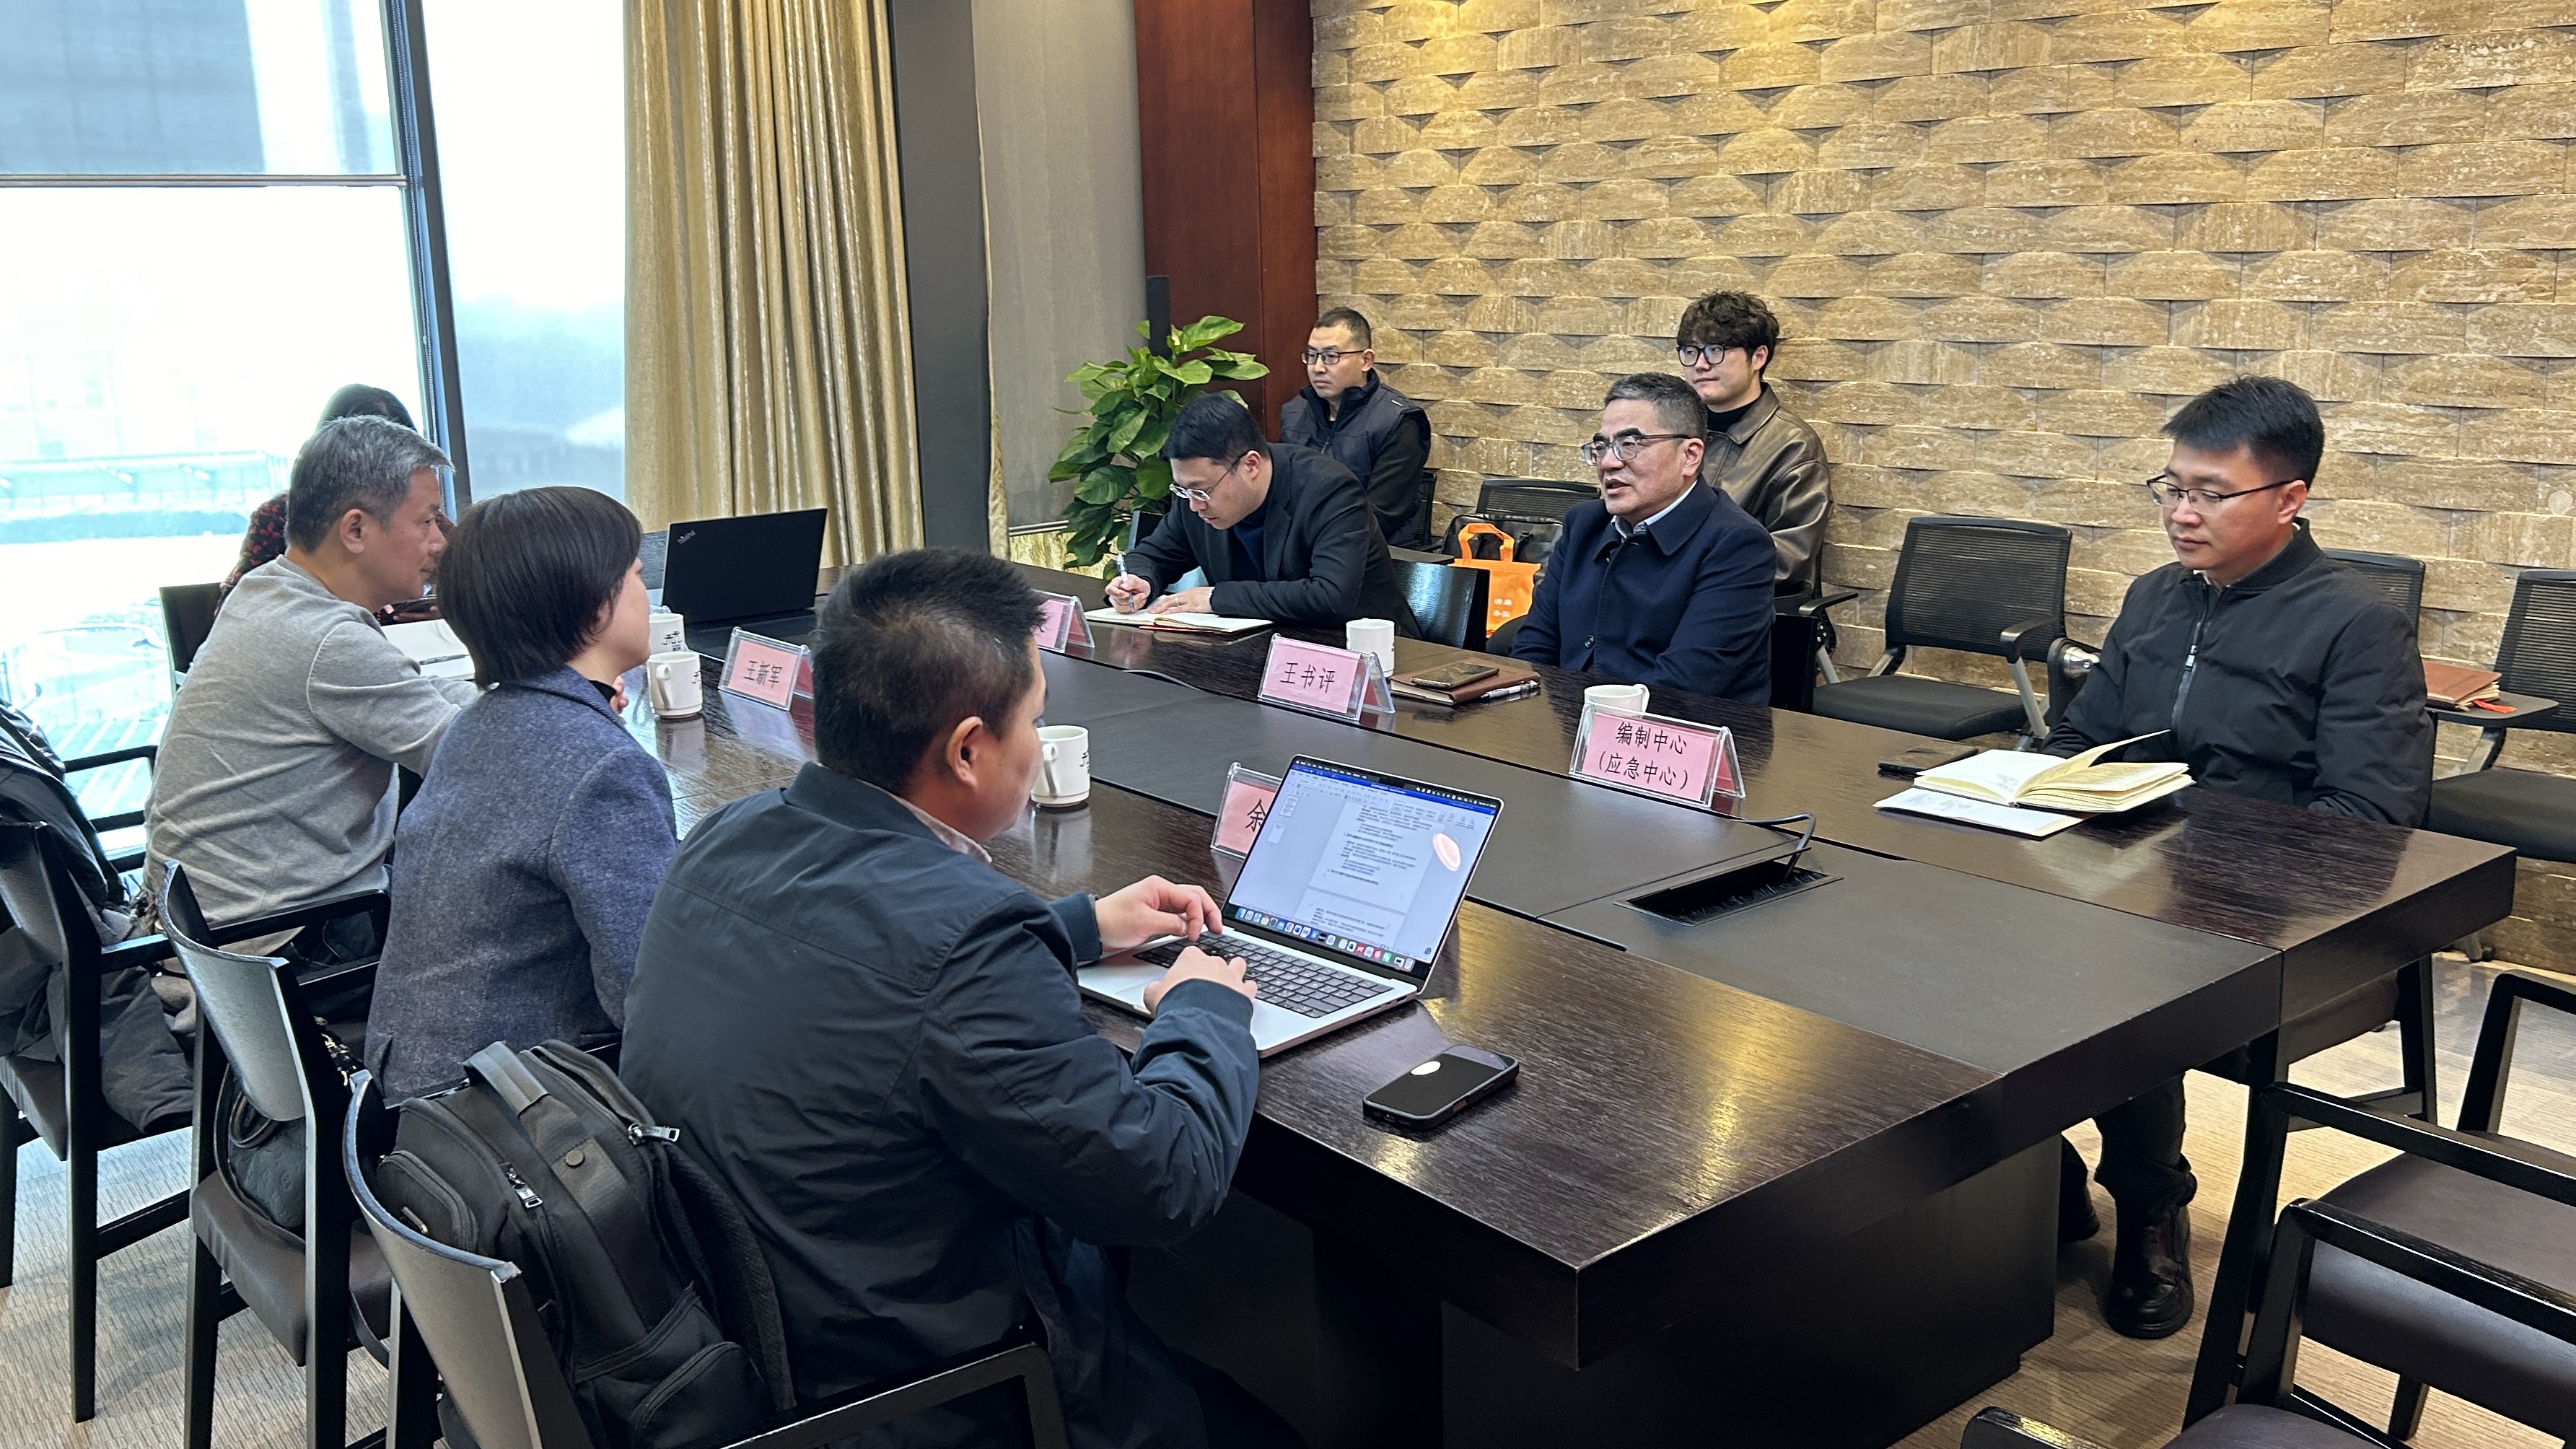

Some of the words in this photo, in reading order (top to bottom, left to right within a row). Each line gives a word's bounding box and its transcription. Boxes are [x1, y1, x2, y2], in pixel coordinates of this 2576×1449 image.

[743, 660, 783, 689] 王新军
[1280, 662, 1336, 693] 王书评
[1615, 721, 1687, 755] 编制中心
[1245, 798, 1266, 833] 余
